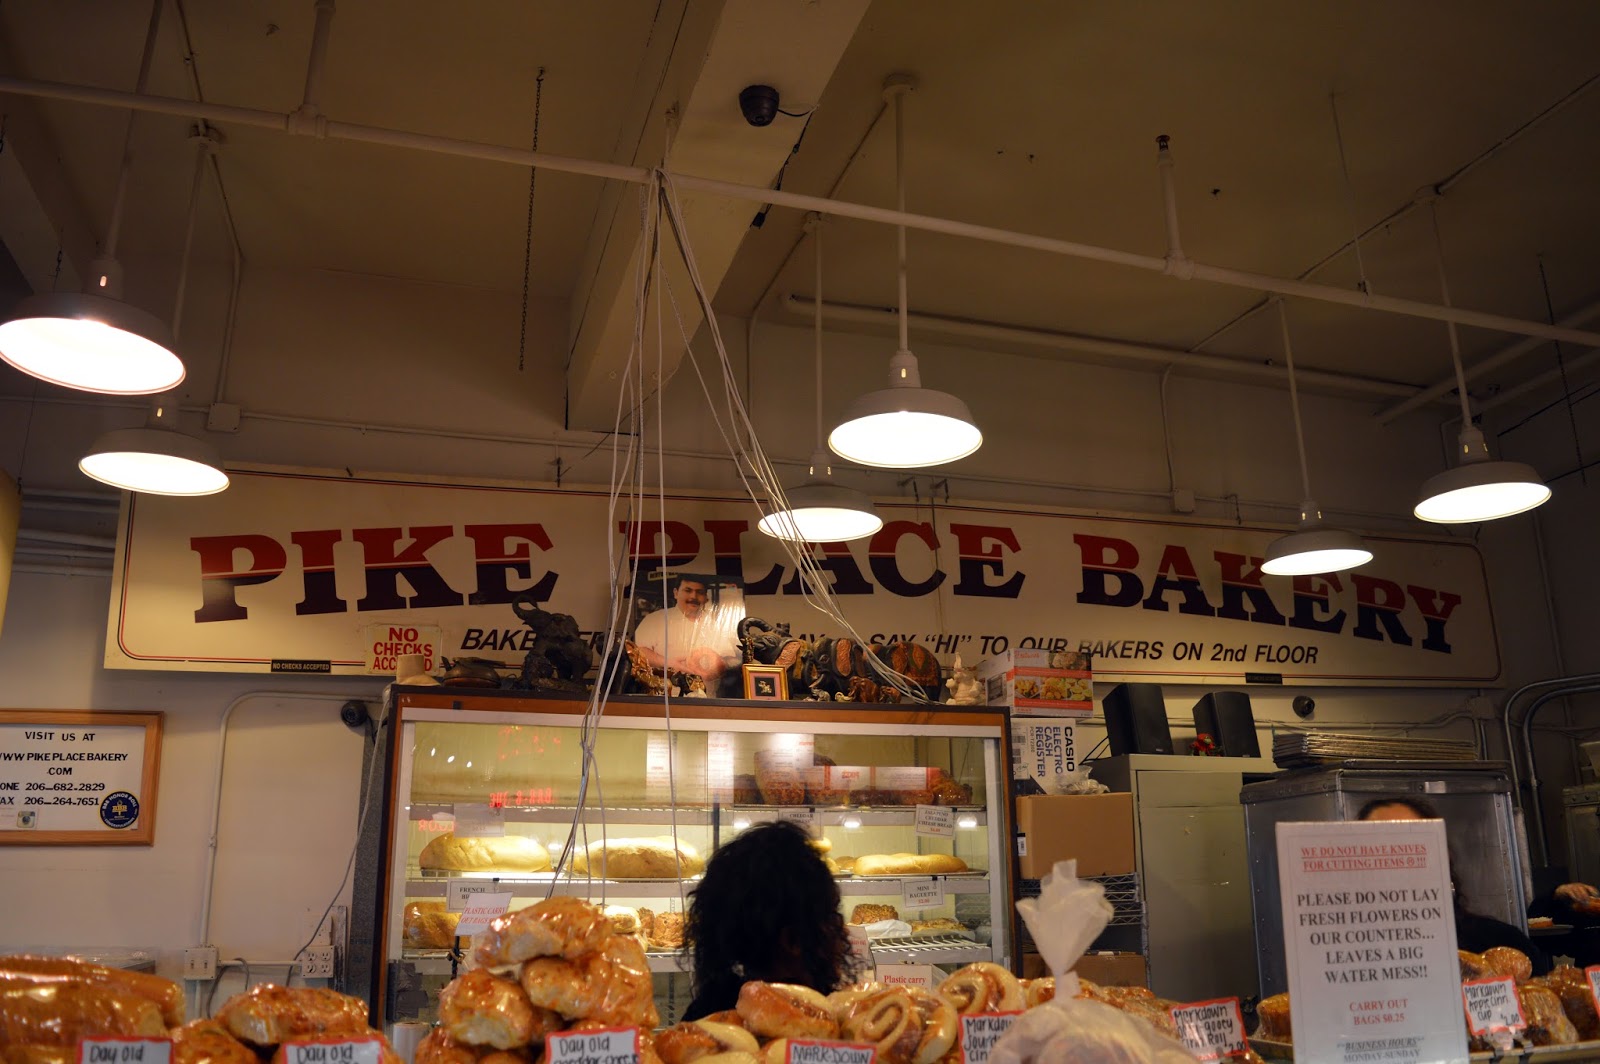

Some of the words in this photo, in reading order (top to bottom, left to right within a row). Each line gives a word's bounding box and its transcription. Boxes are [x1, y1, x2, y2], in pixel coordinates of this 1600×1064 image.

[190, 522, 560, 624] PIKE
[618, 519, 1026, 600] PLACE
[1073, 532, 1463, 655] BAKERY
[388, 627, 419, 642] NO
[373, 641, 433, 657] CHECKS
[980, 635, 1009, 656] TO
[1078, 639, 1164, 659] BAKERS
[1172, 641, 1204, 661] ON
[1210, 642, 1247, 663] 2nd
[1254, 644, 1320, 665] FLOOR
[281, 663, 303, 671] CHECKS
[302, 664, 330, 672] ACCEPTED
[25, 731, 55, 741] VISIT
[62, 733, 76, 742] US
[82, 733, 96, 742] AT
[1044, 726, 1053, 757] CASH
[27, 752, 51, 761] PIKE
[52, 753, 86, 761] PLACE
[86, 753, 129, 762] BAKERY
[1035, 726, 1045, 778] REGISTER
[1064, 726, 1075, 773] CASIO
[1301, 846, 1318, 857] WE
[1319, 845, 1335, 856] DO
[1337, 845, 1358, 856] NOT
[1360, 844, 1388, 856] HAVE
[1389, 842, 1427, 855] KNIVES
[1303, 860, 1325, 870] FOR
[1326, 858, 1372, 870] CUTTING
[1373, 857, 1405, 869] ITEMS
[909, 891, 938, 899] BAGUETTE
[1297, 891, 1351, 907] PLEASE
[1355, 891, 1376, 905] DO
[1378, 889, 1408, 904] NOT
[1412, 887, 1441, 902] LAY
[1299, 911, 1346, 927] FRESH
[1350, 908, 1419, 925] FLOWERS
[1421, 906, 1442, 920] ON
[1309, 930, 1342, 946] OUR
[1345, 927, 1435, 945] COUNTERS...
[1325, 949, 1382, 965] LEAVES
[1385, 948, 1398, 961] A
[1400, 946, 1424, 961] BIG
[884, 974, 907, 984] Plastic
[908, 976, 926, 986] carry
[1324, 968, 1378, 984] WATER
[1381, 965, 1428, 982] MESS!!
[1464, 983, 1507, 1000] Markdown
[1349, 1000, 1384, 1011] CARRY
[1387, 998, 1409, 1009] OUT
[1173, 1005, 1228, 1025] Markdown
[1353, 1014, 1381, 1026] BAGS
[1382, 1012, 1405, 1024] $0.25
[1204, 1018, 1234, 1035] gooey
[90, 1044, 117, 1064] Day
[296, 1045, 326, 1064] Day
[559, 1037, 585, 1058] Day
